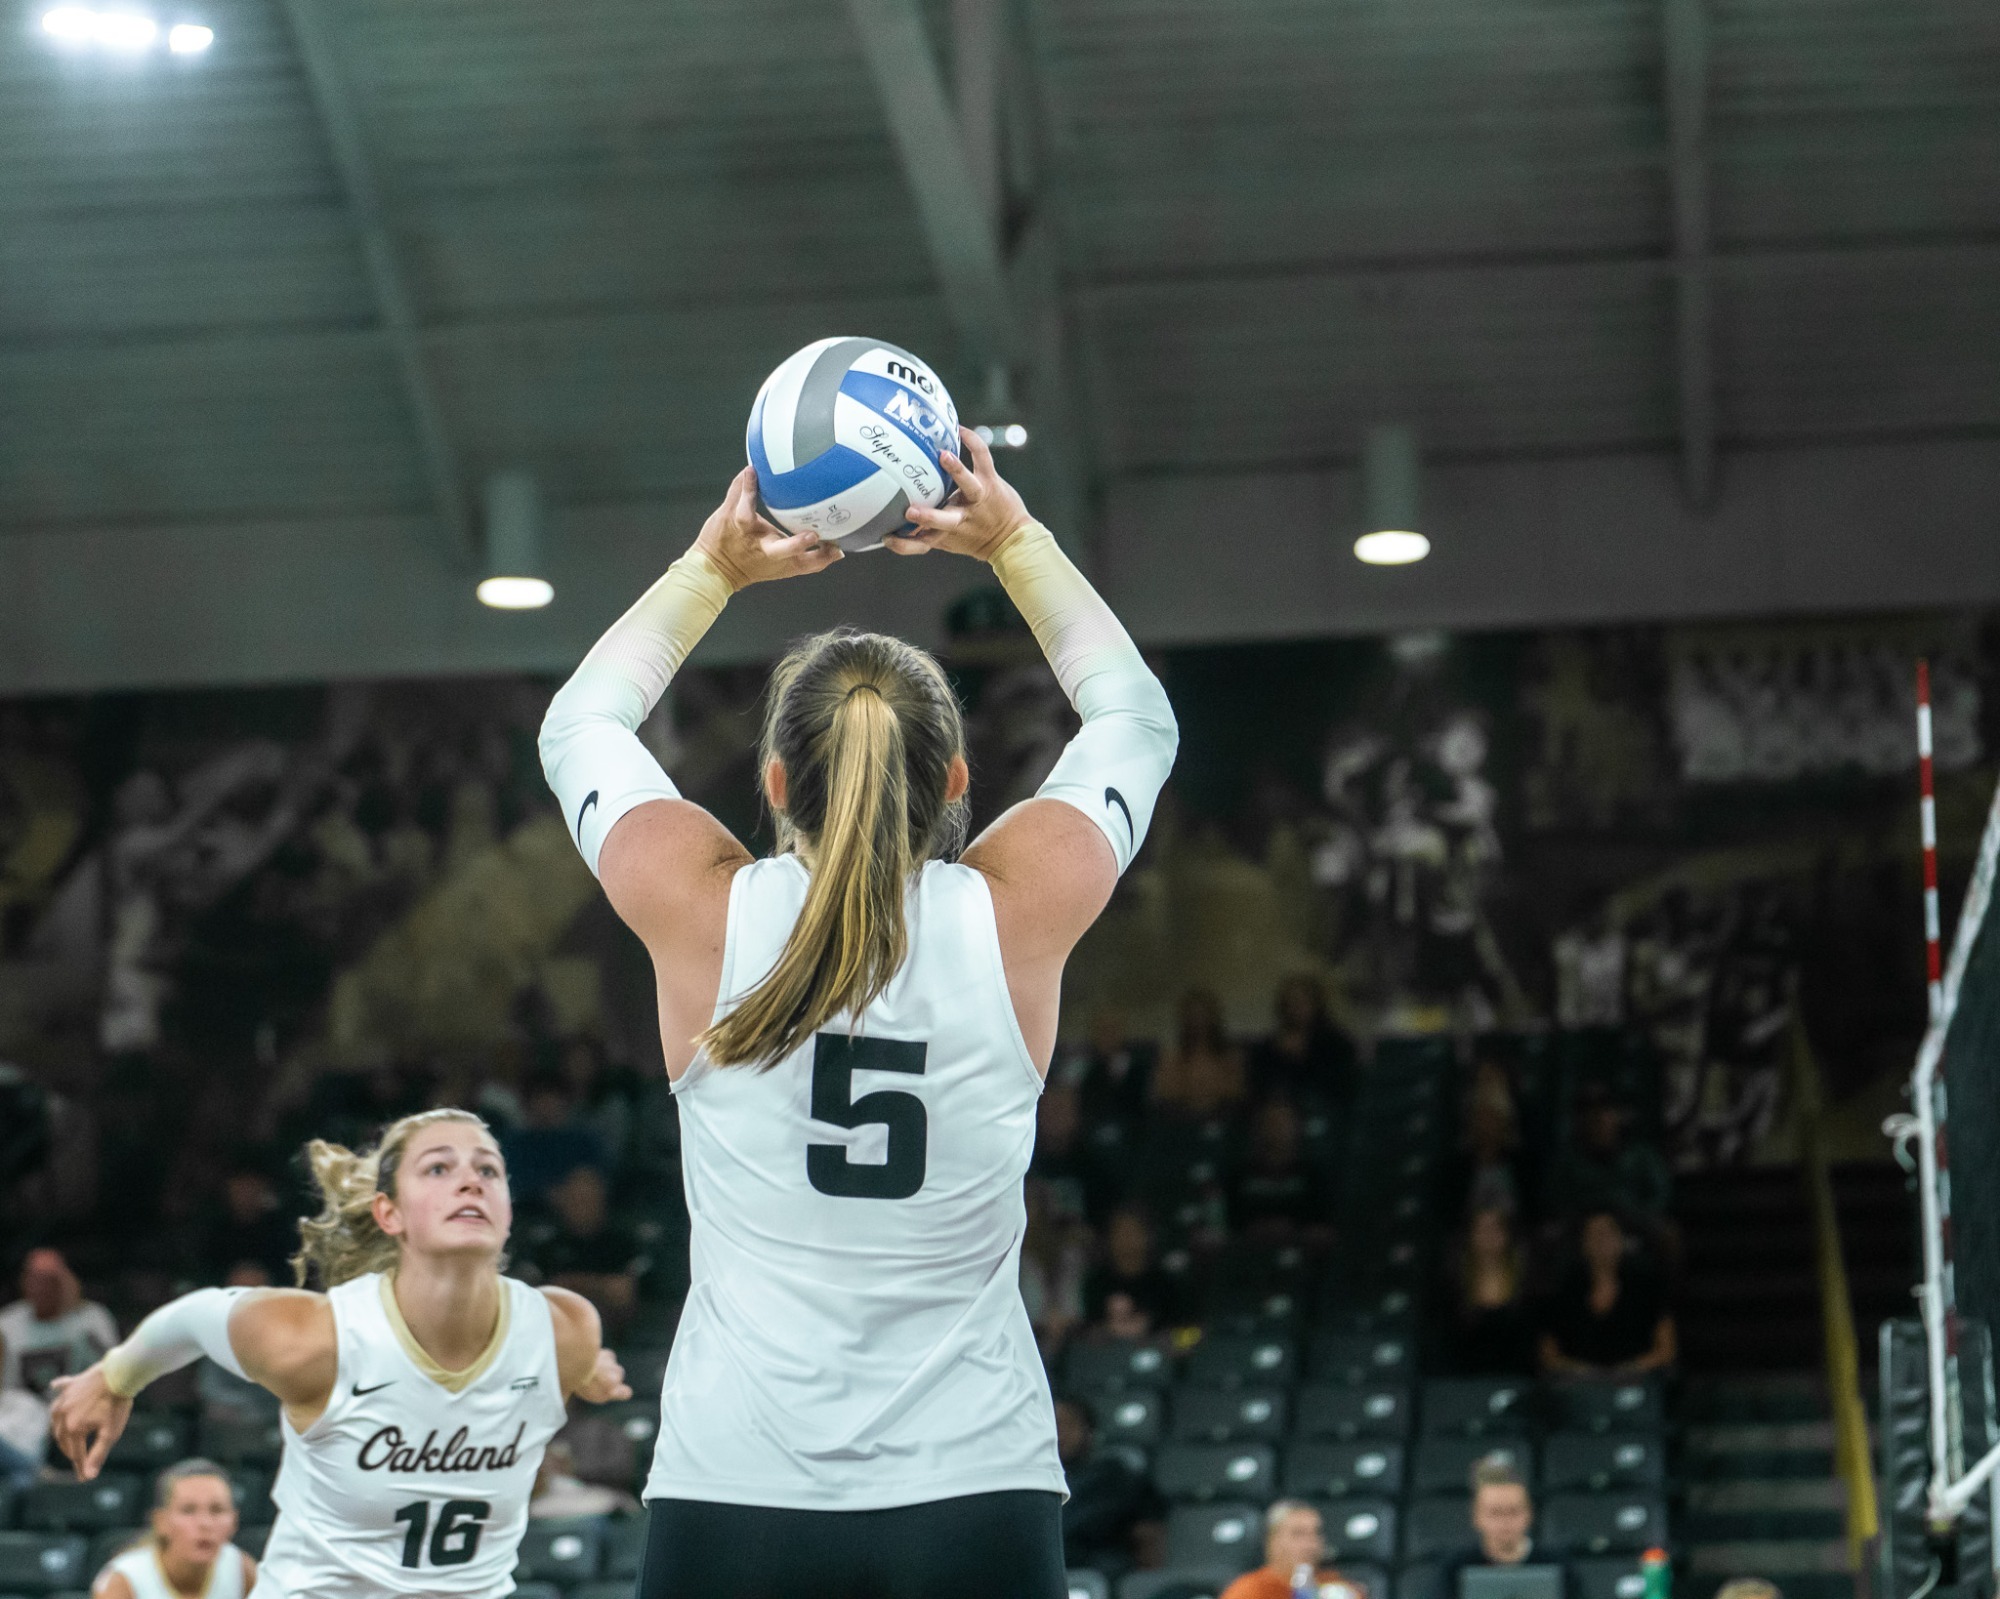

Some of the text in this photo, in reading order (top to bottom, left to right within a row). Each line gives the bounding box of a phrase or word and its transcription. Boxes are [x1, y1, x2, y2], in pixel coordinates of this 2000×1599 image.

[859, 424, 901, 464] Super
[902, 464, 936, 499] Touch
[807, 1032, 928, 1199] 5
[357, 1420, 527, 1473] Oakland
[394, 1499, 492, 1569] 16
